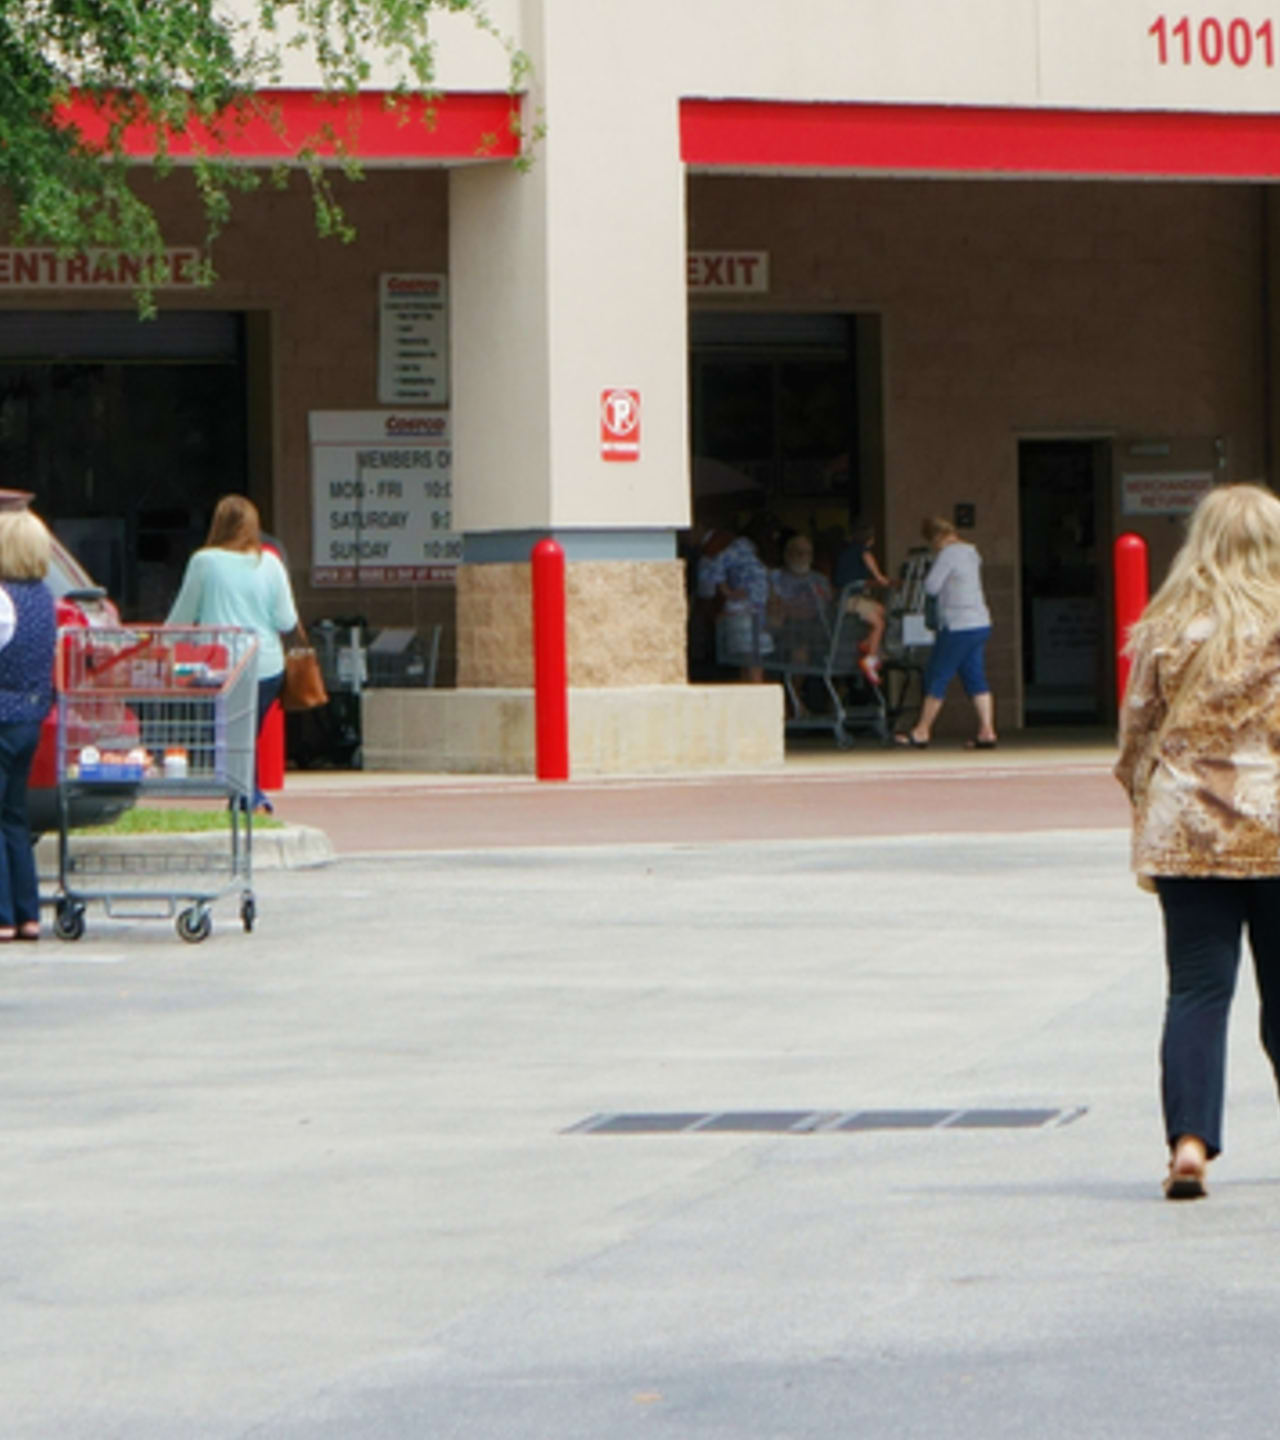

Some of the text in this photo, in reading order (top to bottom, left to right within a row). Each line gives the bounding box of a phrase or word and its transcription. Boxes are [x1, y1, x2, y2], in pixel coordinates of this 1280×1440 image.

[1148, 15, 1275, 68] 11001
[329, 481, 364, 498] MON
[376, 481, 403, 498] FRI
[329, 511, 409, 530] SATURDAY
[329, 540, 391, 560] SUNDAY
